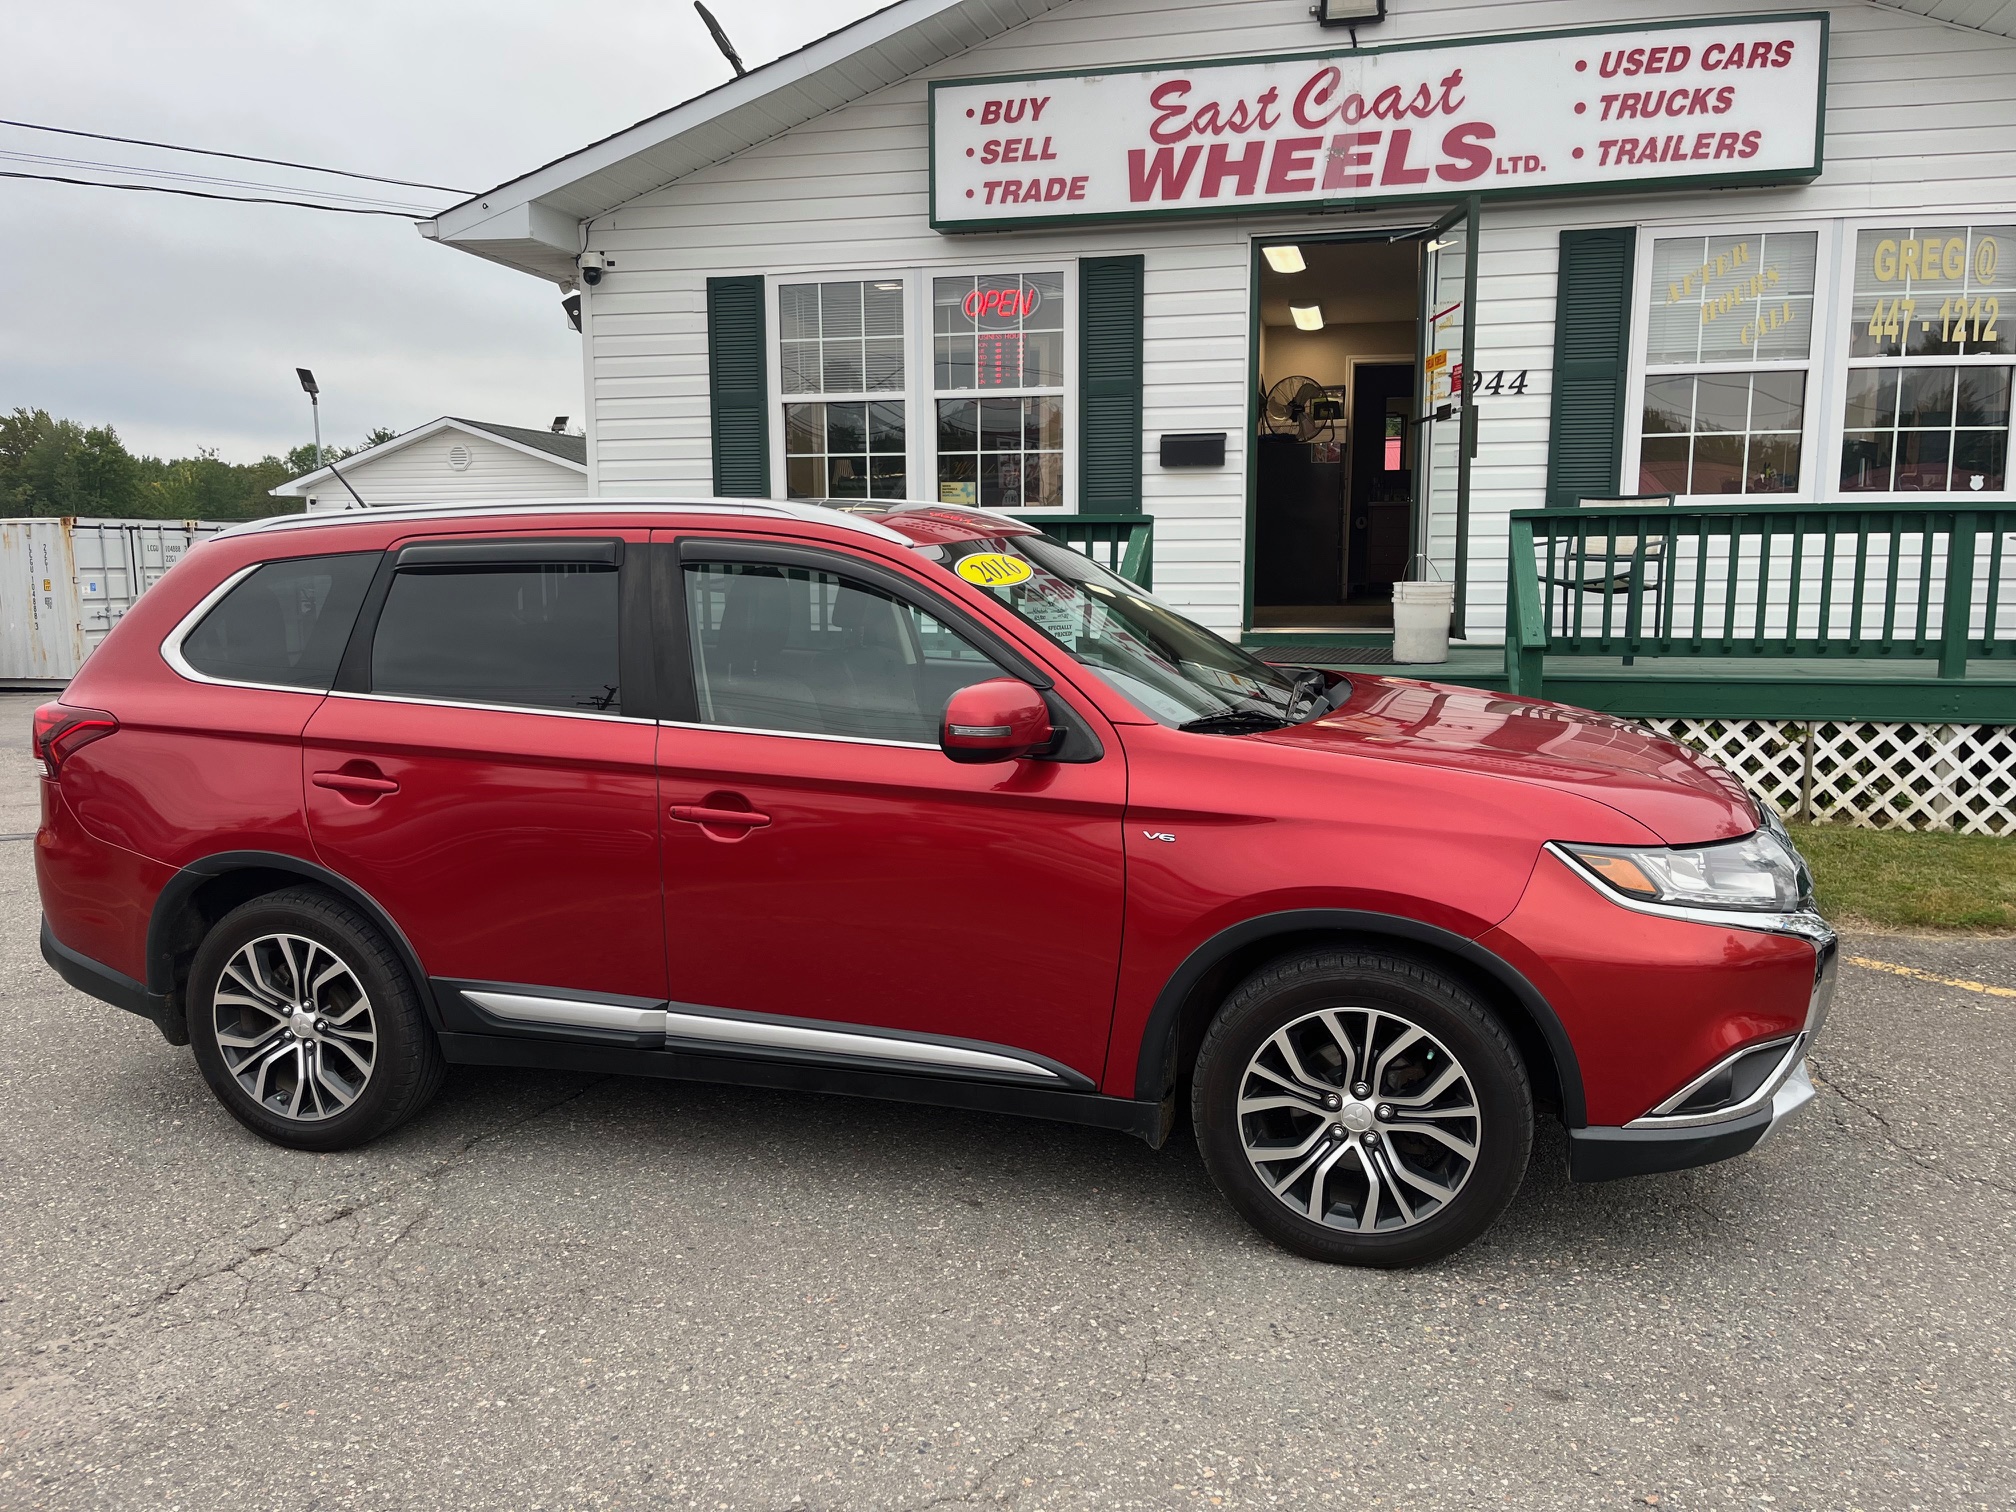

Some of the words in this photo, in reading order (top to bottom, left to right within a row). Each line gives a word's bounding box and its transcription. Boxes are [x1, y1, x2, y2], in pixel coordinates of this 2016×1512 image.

[1600, 45, 1691, 78] USED
[1701, 40, 1795, 71] CARS
[980, 97, 1051, 126] BUY
[1150, 80, 1281, 145] East
[1292, 66, 1466, 130] Coast
[1600, 86, 1735, 121] TRUCKS
[981, 137, 1057, 164] SELL
[1128, 122, 1496, 203] WHEELS
[1495, 155, 1546, 175] LTD.
[1599, 130, 1762, 167] TRAILERS
[983, 176, 1089, 205] TRADE
[1664, 242, 1749, 307] AFTER
[1874, 237, 1965, 281] GREG
[1974, 236, 1998, 285] @
[965, 288, 1034, 317] OPEN
[1701, 264, 1780, 325] HOURS
[1740, 300, 1796, 346] CALL
[970, 556, 1022, 583] 2016
[1142, 830, 1176, 842] V6
